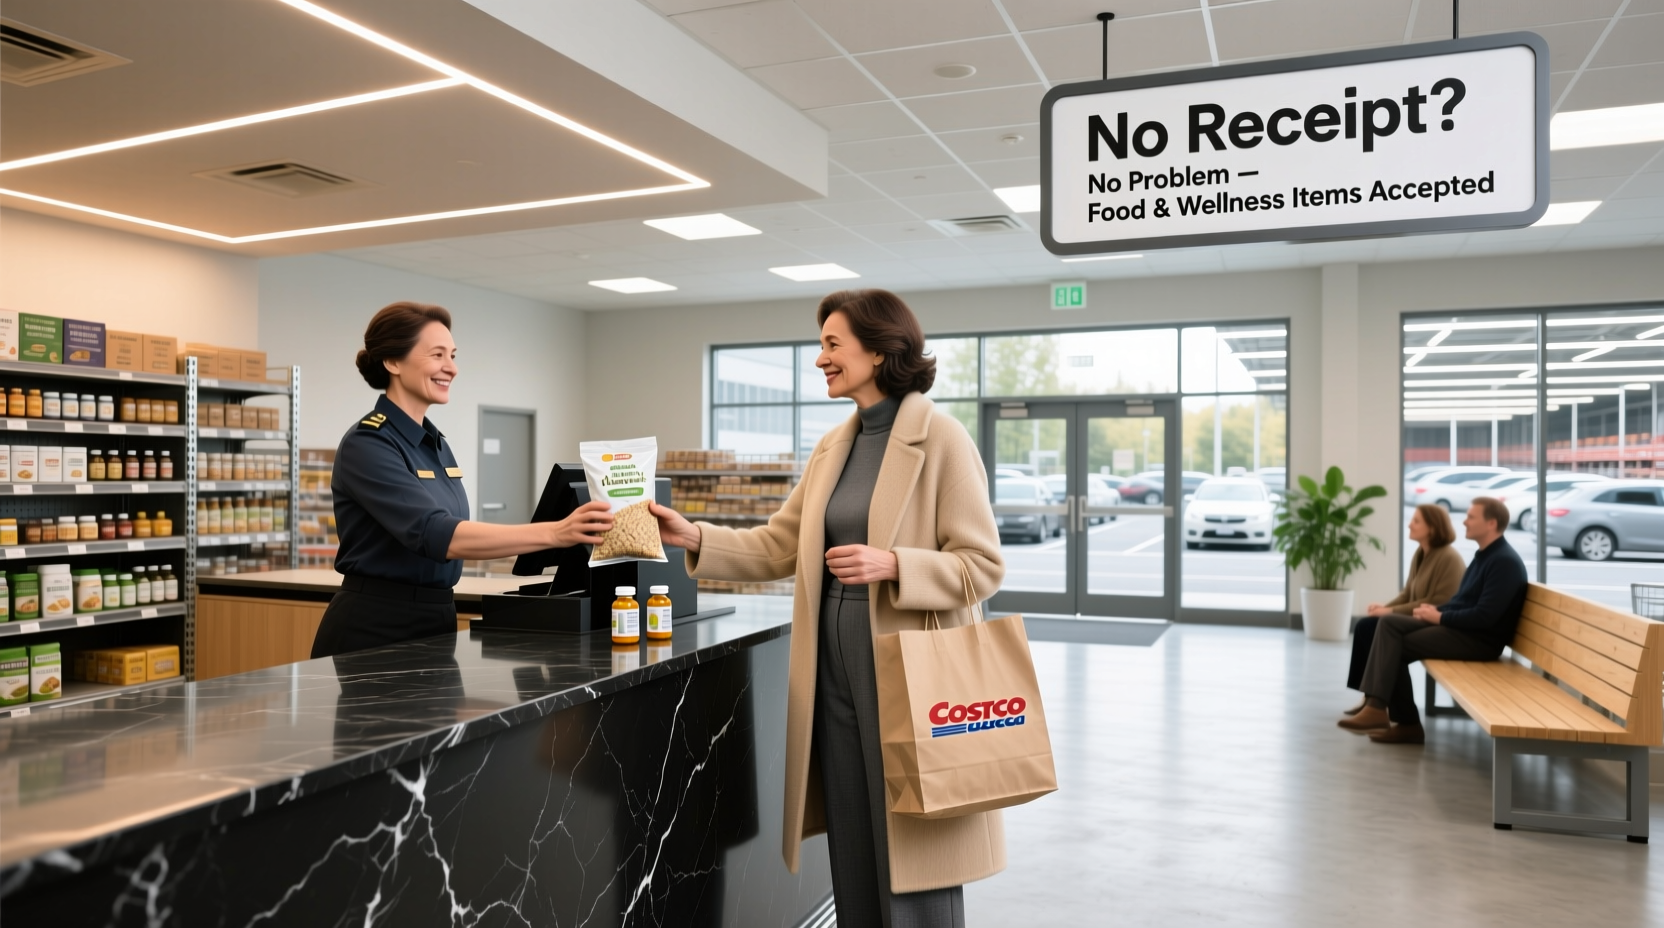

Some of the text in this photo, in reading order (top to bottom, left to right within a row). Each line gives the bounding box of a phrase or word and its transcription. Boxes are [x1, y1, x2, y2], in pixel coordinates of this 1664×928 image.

[1088, 77, 1467, 162] No Receipt?
[1088, 173, 1122, 195] No
[1129, 166, 1230, 192] Problem
[1088, 171, 1495, 223] Food & Wellness Items Accepted
[929, 697, 1026, 725] COSTCO
